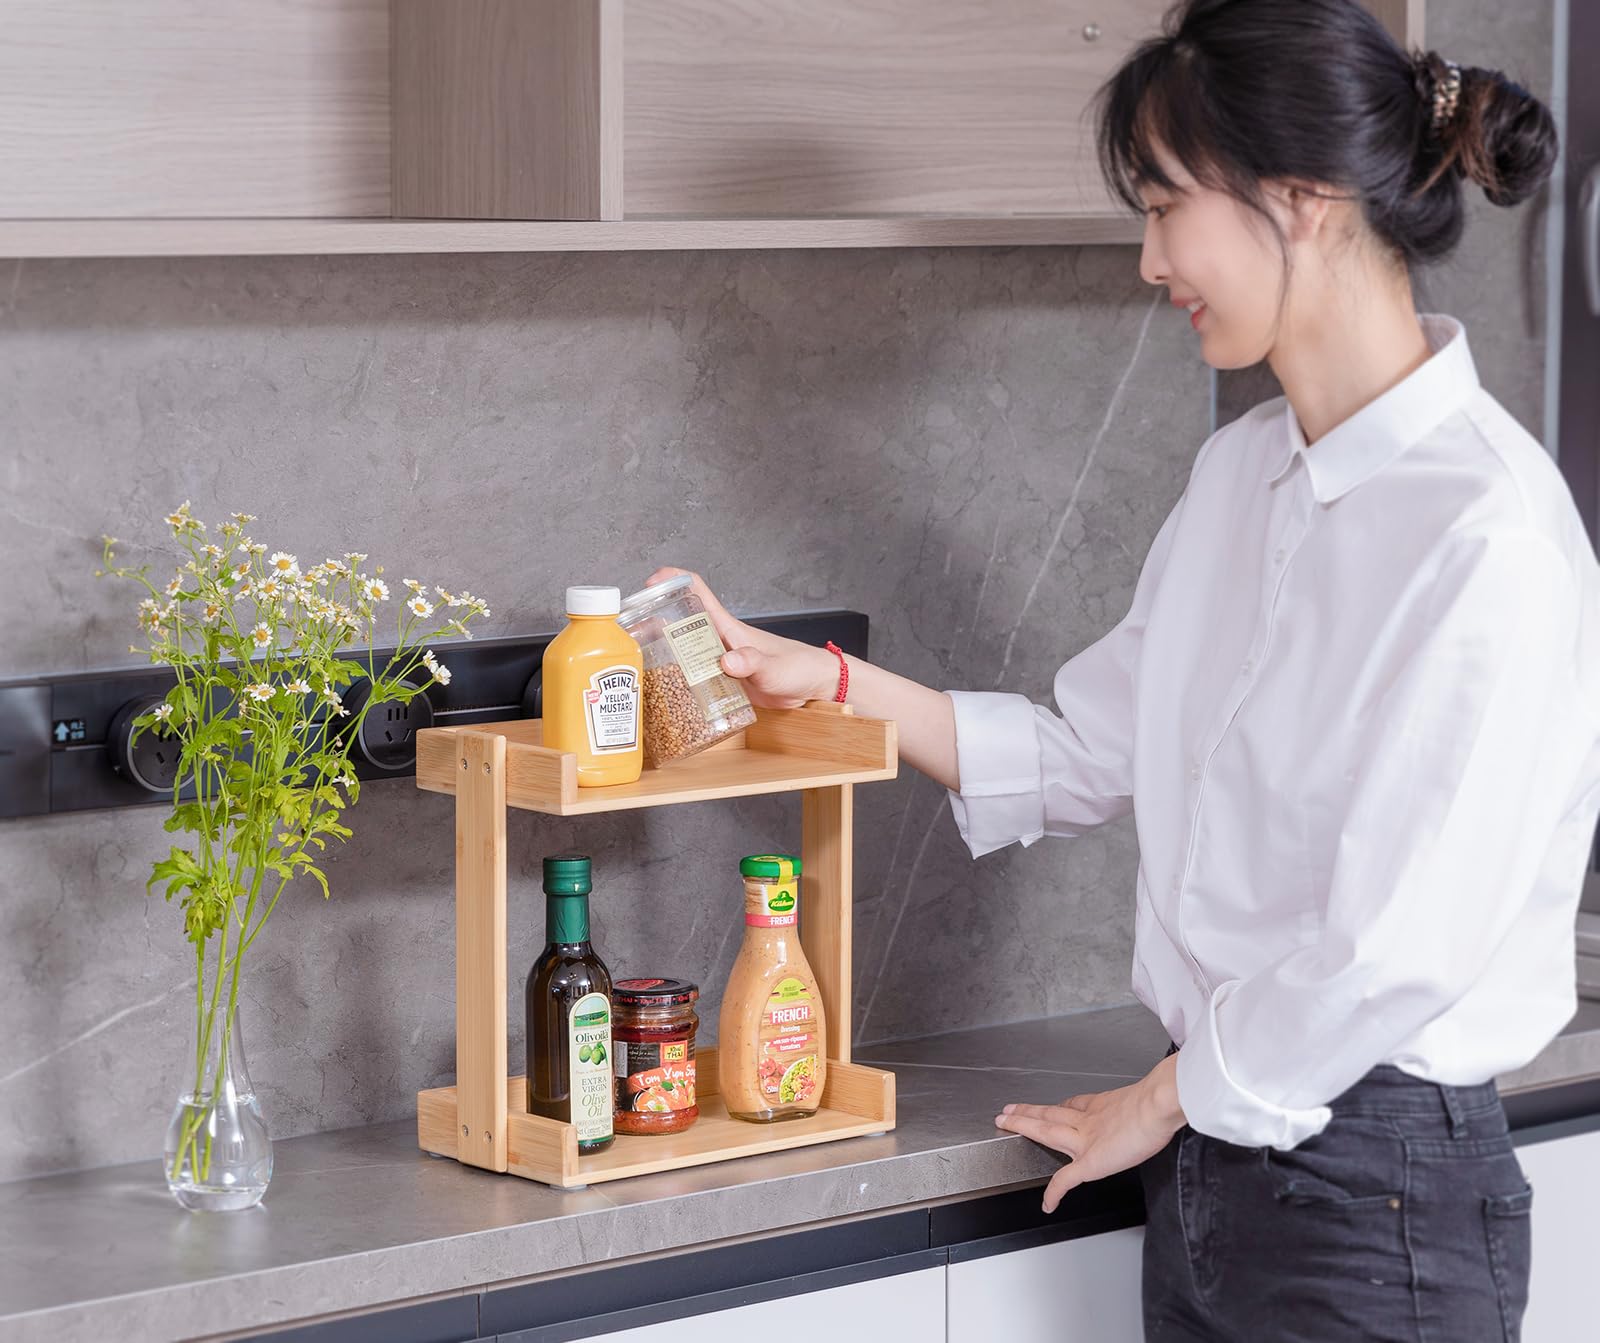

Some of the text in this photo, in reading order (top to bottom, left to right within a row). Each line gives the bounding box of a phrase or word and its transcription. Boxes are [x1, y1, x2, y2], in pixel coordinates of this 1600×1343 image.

[603, 676, 631, 690] HEINZ
[604, 693, 630, 703] YELLOW
[599, 702, 633, 714] MUSTARD
[772, 1007, 808, 1023] FRENCH
[581, 1076, 607, 1086] EXTRA
[635, 1074, 660, 1086] Tom
[663, 1067, 684, 1080] Yum
[581, 1082, 607, 1093] VIRGIN
[581, 1094, 607, 1106] Olive
[587, 1104, 603, 1117] Oil
